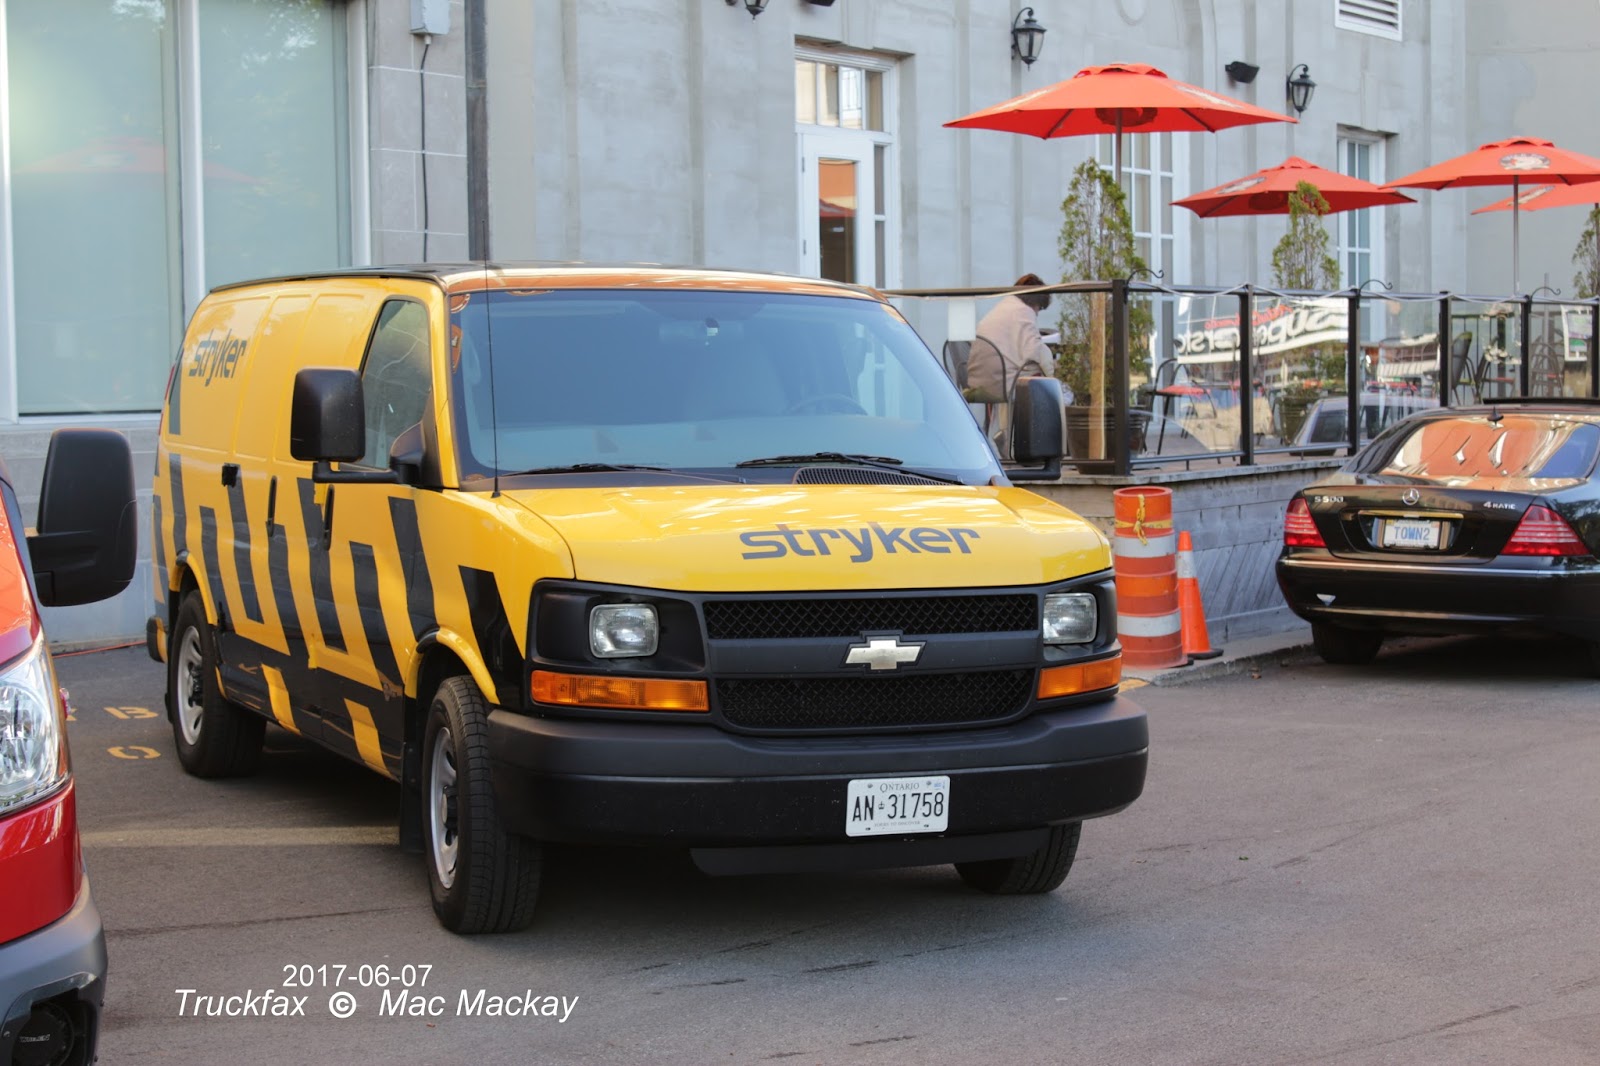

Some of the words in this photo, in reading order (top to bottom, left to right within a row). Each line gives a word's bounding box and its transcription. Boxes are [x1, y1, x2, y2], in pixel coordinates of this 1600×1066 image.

[188, 328, 248, 387] stryker
[739, 521, 981, 563] stryker
[1394, 526, 1430, 541] TOWN2
[887, 792, 944, 819] 31758
